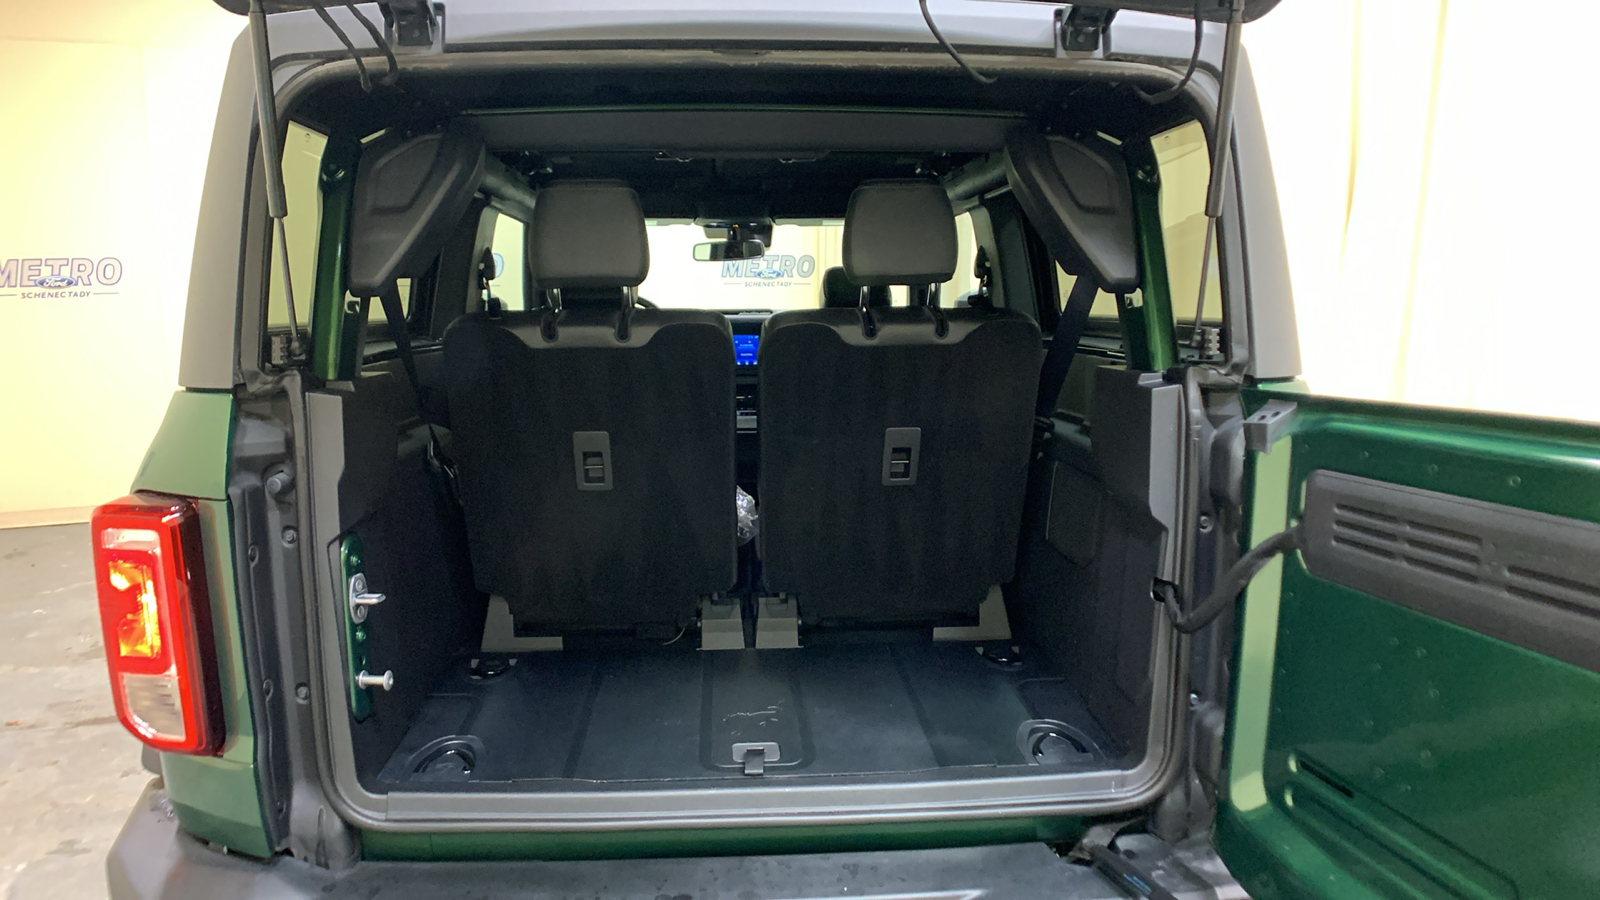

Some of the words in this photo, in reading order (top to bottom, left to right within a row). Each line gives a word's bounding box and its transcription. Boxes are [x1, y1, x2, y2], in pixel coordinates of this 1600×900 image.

[0, 257, 122, 288] METRO
[721, 255, 815, 278] METRO
[21, 291, 91, 299] SCHENECTADY
